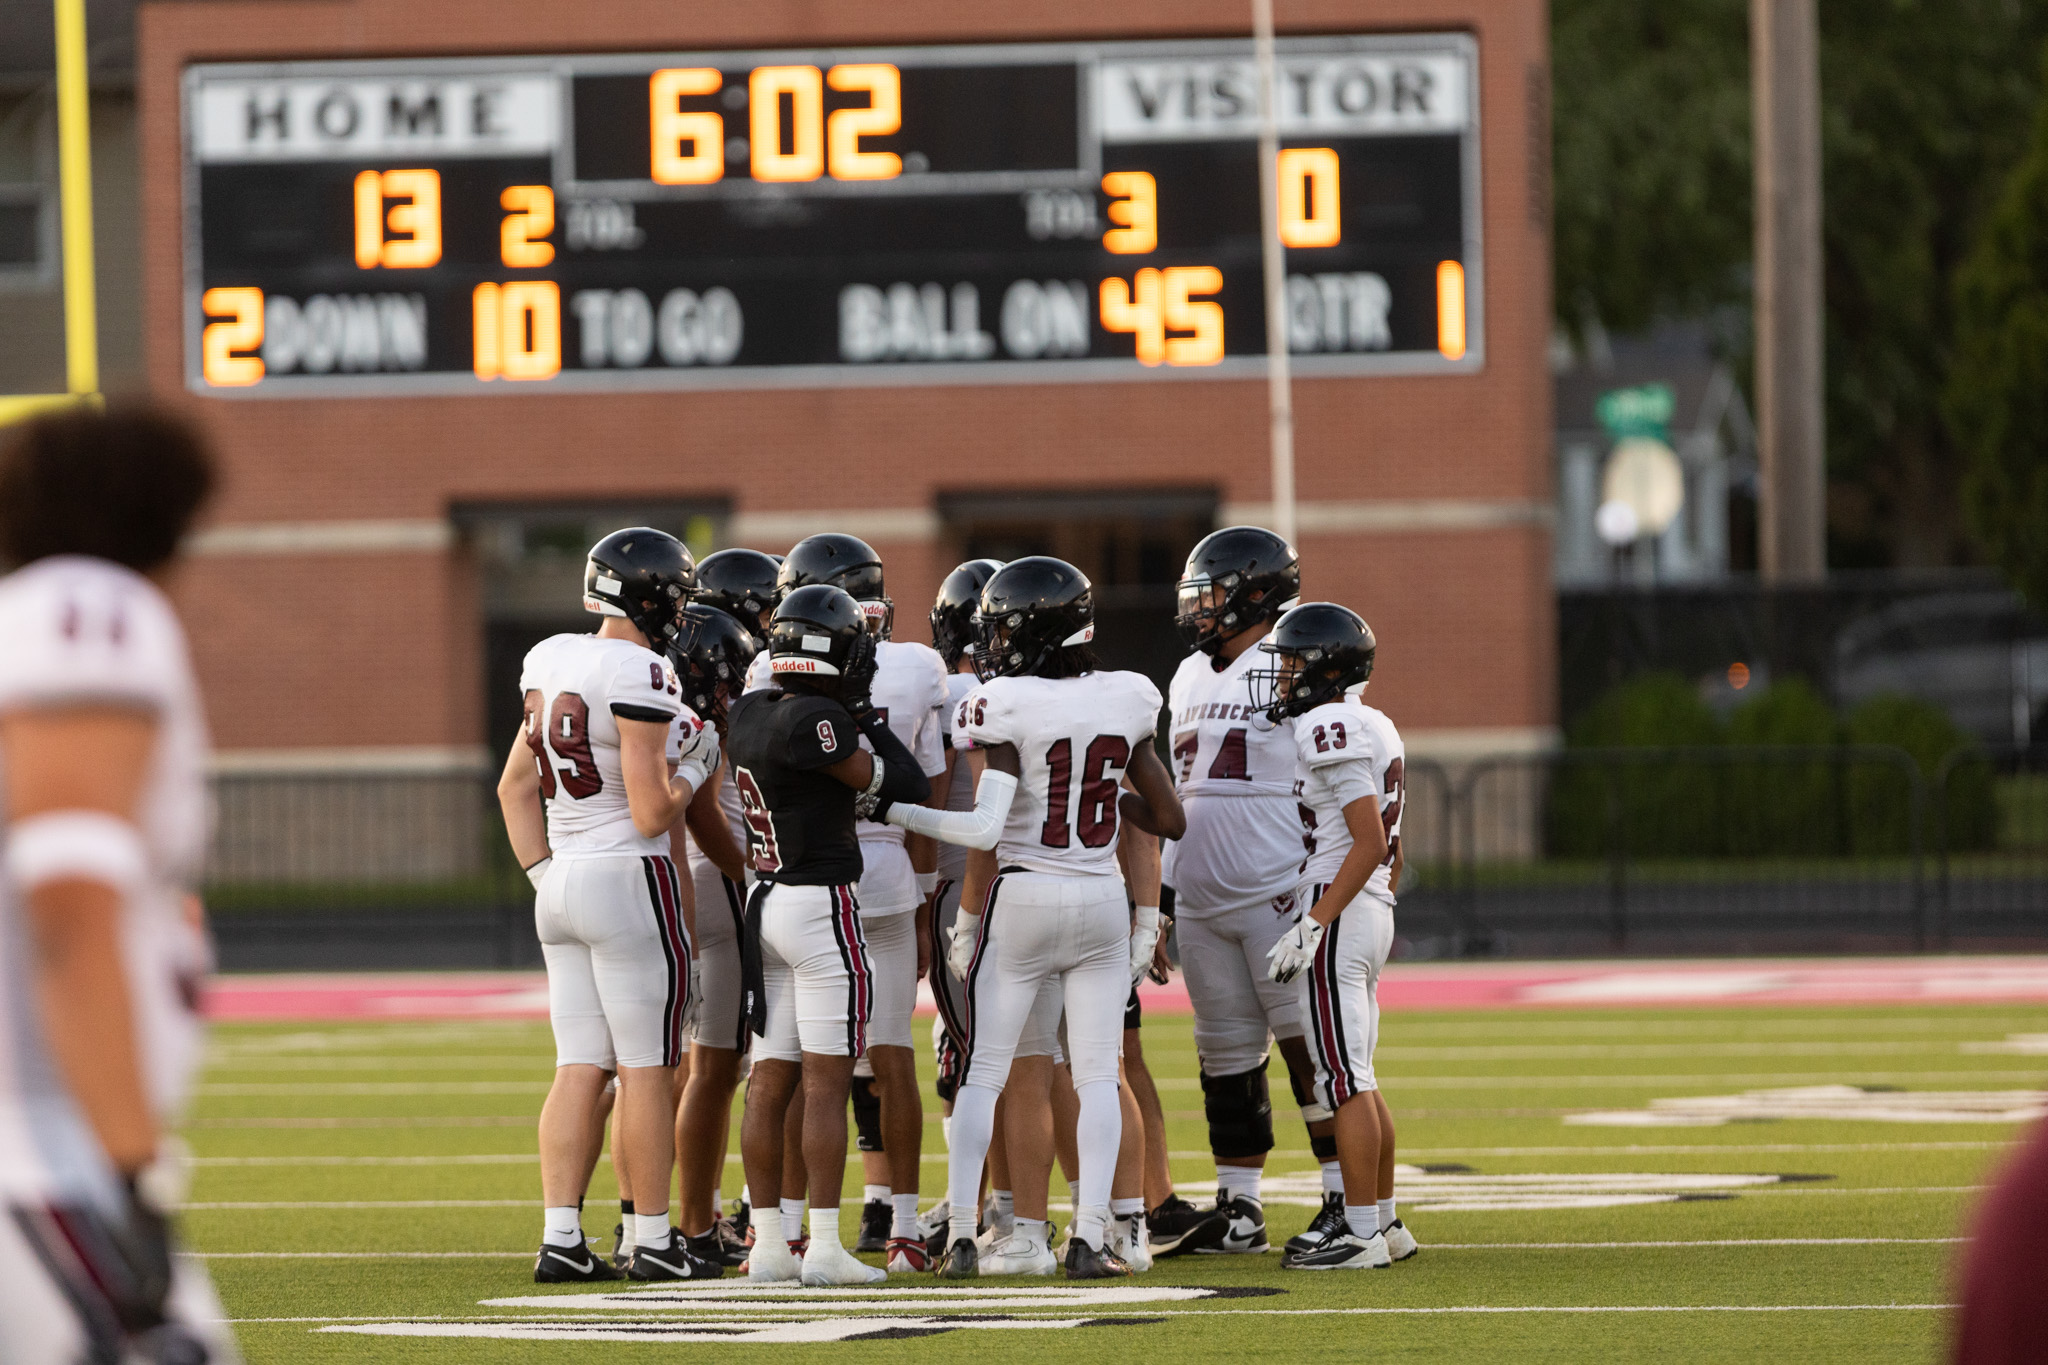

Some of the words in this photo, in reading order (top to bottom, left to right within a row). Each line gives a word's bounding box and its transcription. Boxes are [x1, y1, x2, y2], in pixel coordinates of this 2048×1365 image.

[245, 86, 518, 140] HOME
[1130, 64, 1434, 121] VISTOR
[354, 168, 442, 270] 13
[501, 185, 555, 268] 2
[1102, 171, 1158, 254] 3
[1277, 147, 1341, 248] 0
[202, 287, 265, 387] 2
[264, 293, 427, 373] DOWN
[473, 280, 562, 381] 10
[571, 288, 655, 367] TO
[657, 286, 744, 366] GO
[838, 282, 997, 362] BALL
[1001, 280, 1091, 359] ON
[1099, 266, 1225, 367] 45
[1437, 260, 1465, 361] 1
[772, 661, 816, 672] Riddell
[816, 719, 838, 753] 9
[1174, 727, 1253, 784] 74
[1312, 721, 1348, 753] 23
[736, 765, 783, 874] 9
[1041, 734, 1130, 849] 16
